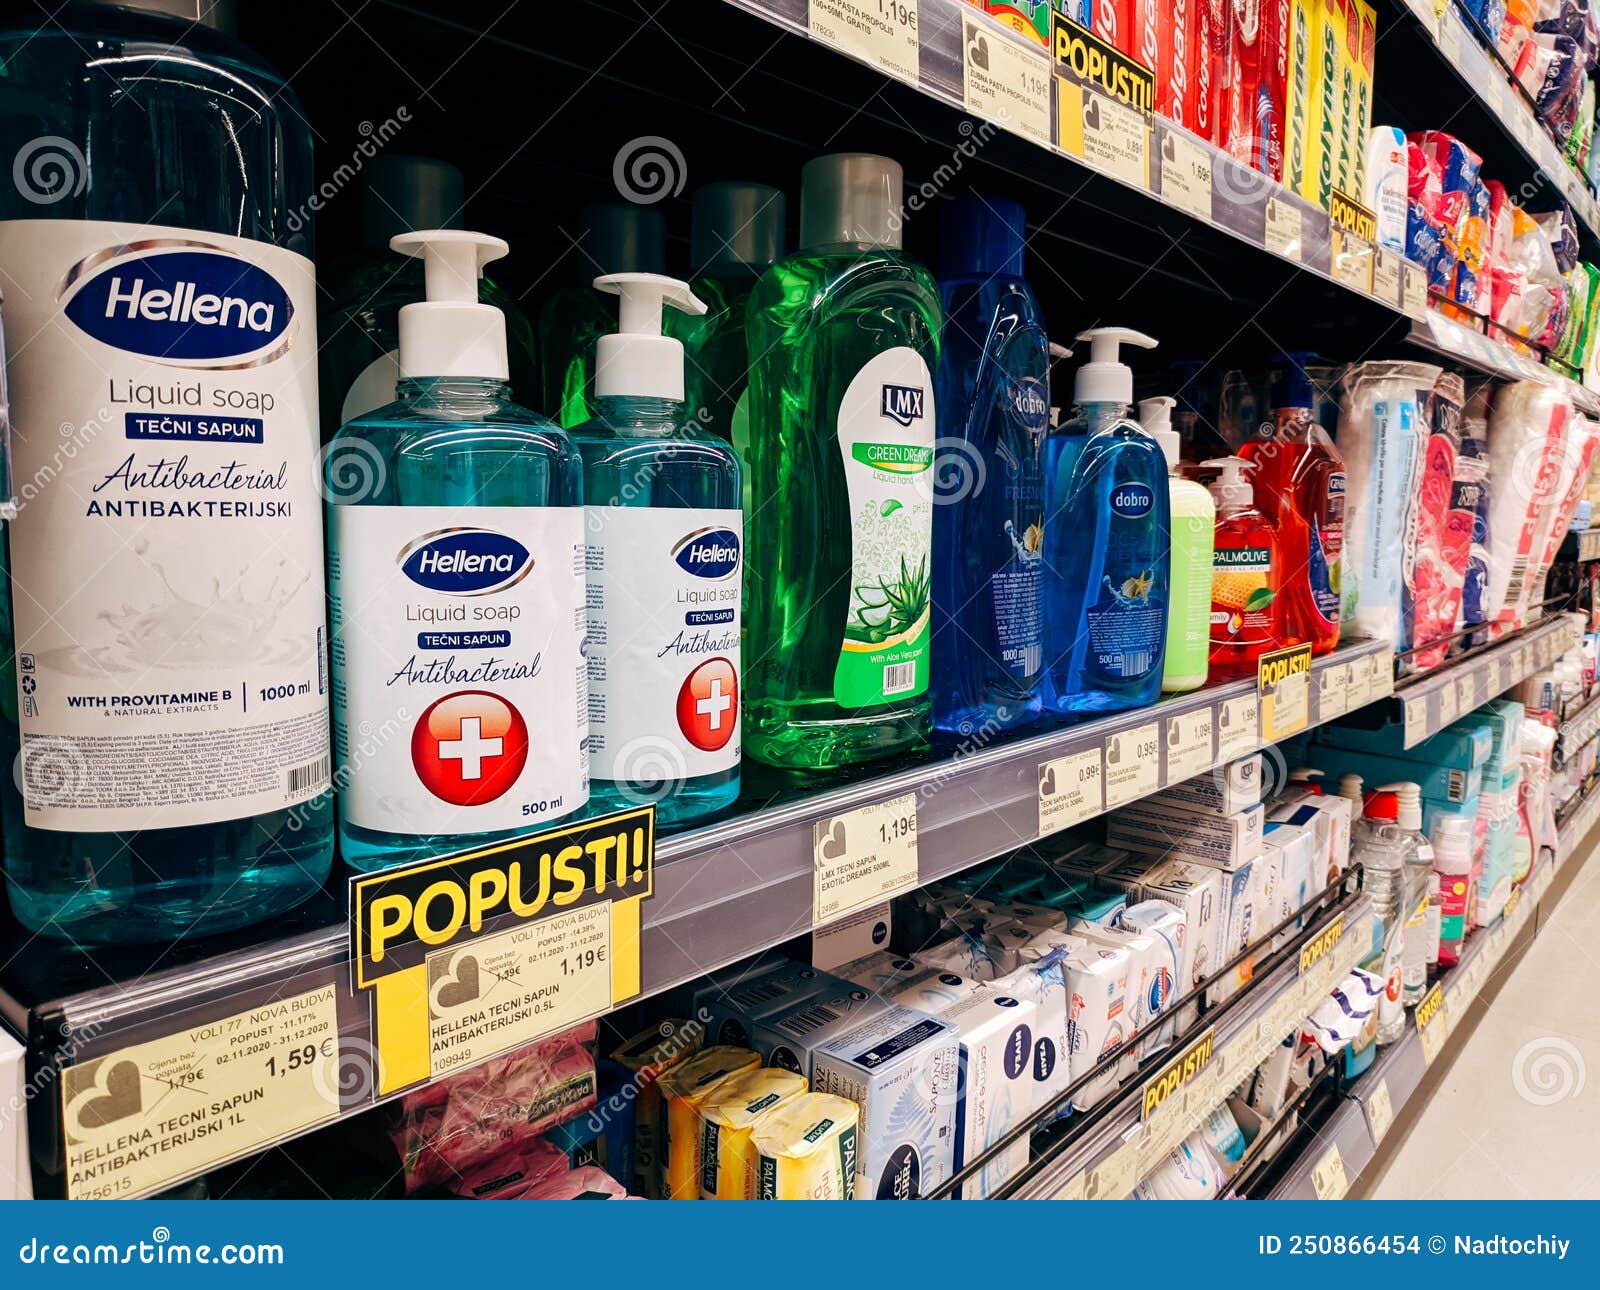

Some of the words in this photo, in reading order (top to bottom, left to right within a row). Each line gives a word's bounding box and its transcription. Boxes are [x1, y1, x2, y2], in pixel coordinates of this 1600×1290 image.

[846, 16, 871, 35] GRATIS
[861, 11, 894, 36] PROPOLIS
[1055, 26, 1153, 116] POPUSTI!
[1198, 14, 1210, 129] Colgate
[970, 79, 996, 98] COLGATE
[989, 78, 1007, 92] PASTA
[1007, 88, 1031, 106] PROPOLIS
[1021, 72, 1048, 98] 1,19€
[1290, 6, 1306, 196] Kolynos
[1319, 24, 1335, 212] Kolynos
[1337, 64, 1352, 197] olynos
[1353, 80, 1366, 204] olynos
[105, 276, 275, 333] Hellena
[109, 378, 202, 409] Liquid
[212, 388, 275, 415] soap
[885, 386, 923, 420] LMX
[1015, 394, 1046, 415] dobro
[136, 416, 192, 436] TEČNI
[197, 421, 257, 439] SAPUN
[867, 446, 902, 461] GREEN
[903, 447, 929, 463] DREAMS
[92, 452, 289, 493] Antibacterial
[873, 470, 897, 484] Liquid
[897, 473, 914, 486] hand
[86, 500, 292, 518] ANTIBAKTERIJSKI
[1115, 491, 1149, 508] dobro
[418, 549, 514, 574] Hellena
[689, 544, 738, 564] Hellena
[1213, 550, 1268, 563] PALMOLIVE
[676, 586, 717, 604] Liquid
[405, 602, 466, 625] Liquid
[472, 602, 521, 623] soap
[690, 610, 714, 623] TEČNI
[715, 609, 733, 621] SAPUN
[424, 633, 461, 647] TEČNI
[463, 632, 506, 646] SAPUN
[870, 654, 886, 664] With
[886, 651, 900, 662] Aloe
[1002, 649, 1018, 662] 1000
[1099, 653, 1114, 664] 500
[386, 652, 543, 687] Antibacterial
[1261, 652, 1310, 691] POPUSTI!
[67, 695, 107, 708] WITH
[111, 690, 218, 707] PROVITAMINE
[222, 689, 232, 701] B
[259, 684, 296, 702] 1000
[298, 681, 312, 695] ml
[114, 707, 163, 717] NATURAL
[166, 704, 219, 716] EXTRACTS
[1079, 763, 1100, 782] 0,99€
[521, 801, 548, 817] 500
[550, 796, 564, 810] ml
[880, 814, 916, 844] 1,19€
[821, 868, 836, 880] LMX
[836, 862, 855, 876] TECNI
[856, 853, 877, 868] SAPUN
[821, 875, 845, 891] EXOTIC
[846, 866, 872, 883] DREAMS
[370, 827, 645, 964] POPUSTI!
[510, 928, 535, 946] VOLI
[536, 924, 548, 938] 77
[551, 915, 577, 931] NOVA
[578, 906, 609, 924] BUDVA
[528, 945, 564, 965] 02.11.2020
[569, 931, 604, 953] 31.12.2020
[537, 932, 567, 949] POPUST
[1301, 917, 1344, 972] POPUSTI!
[484, 953, 503, 967] Cijena
[504, 949, 516, 961] bez
[560, 943, 607, 978] 1,19€
[189, 1025, 224, 1045] VOLI
[227, 1018, 243, 1033] 77
[249, 1005, 288, 1026] NOVA
[291, 989, 335, 1013] BUDVA
[431, 1011, 486, 1039] HELLENA
[489, 997, 522, 1018] TECNI
[524, 983, 561, 1006] SAPUN
[230, 1024, 274, 1047] POPUST
[280, 1012, 317, 1031] -11.17%
[432, 1005, 532, 1053] ANTIBAKTERIJSKI
[534, 999, 556, 1016] 0.5L
[216, 1040, 271, 1066] 02.11.2020
[279, 1021, 329, 1047] 31.12.2020
[148, 1054, 178, 1073] Cijena
[181, 1050, 196, 1065] bez
[264, 1037, 334, 1080] 1,59€
[432, 1048, 472, 1074] 109949
[155, 1063, 192, 1082] popusta
[167, 1068, 206, 1092] 1,79€
[929, 1053, 943, 1114] SAPONE
[1144, 1038, 1212, 1119] POPUSTI!
[70, 1127, 153, 1168] HELLENA
[157, 1107, 207, 1136] TECNI
[210, 1087, 266, 1118] SAPUN
[71, 1118, 223, 1186] ANTIBAKTERIJSKI
[228, 1111, 246, 1128] 1L
